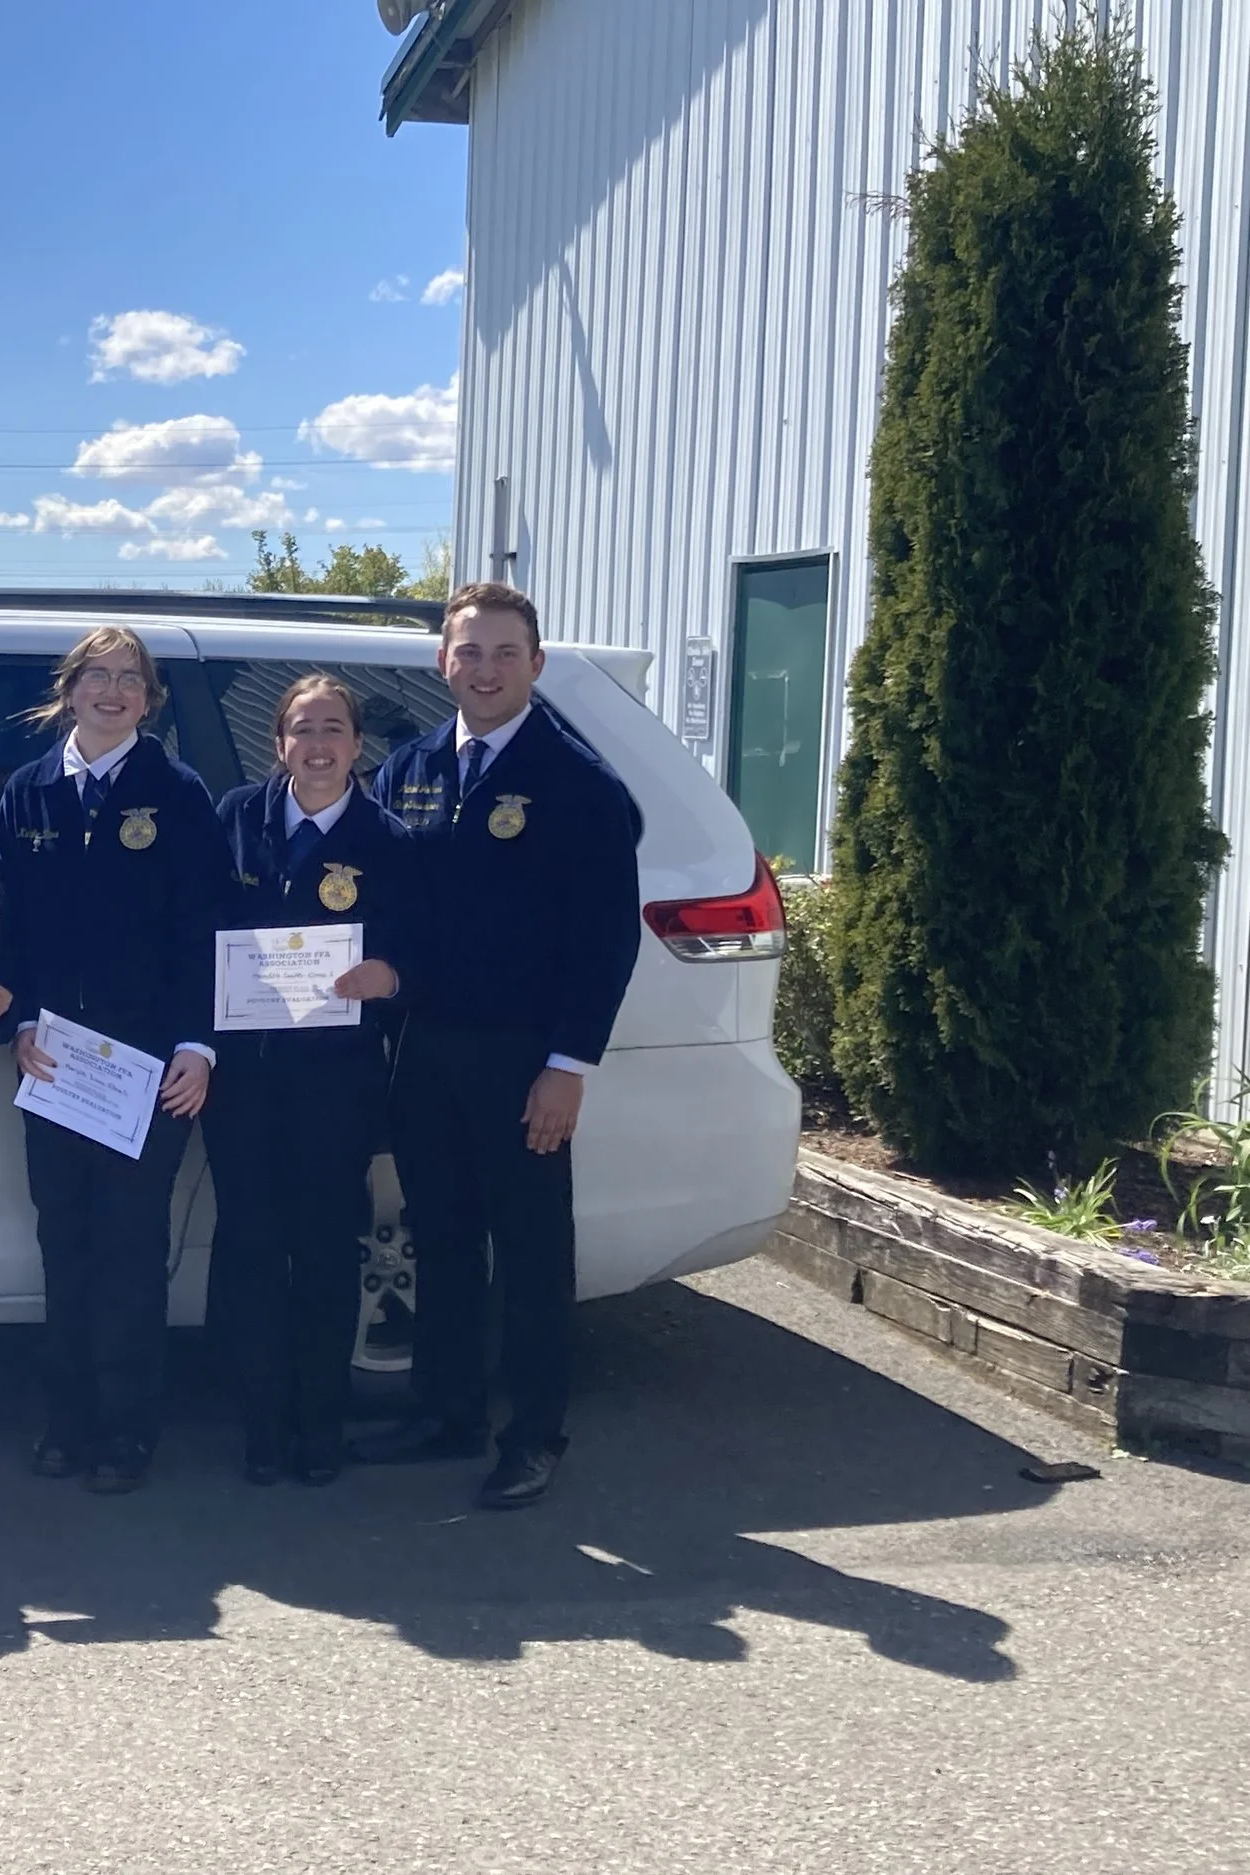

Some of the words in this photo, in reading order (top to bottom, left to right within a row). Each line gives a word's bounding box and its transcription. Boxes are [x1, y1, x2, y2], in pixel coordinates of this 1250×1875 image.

[247, 951, 313, 960] WASHINGTON
[259, 959, 320, 967] ASSOCIATION
[62, 1041, 118, 1072] WASHINGTON
[117, 1065, 133, 1079] FFA
[69, 1053, 123, 1081] ASSOCIATION
